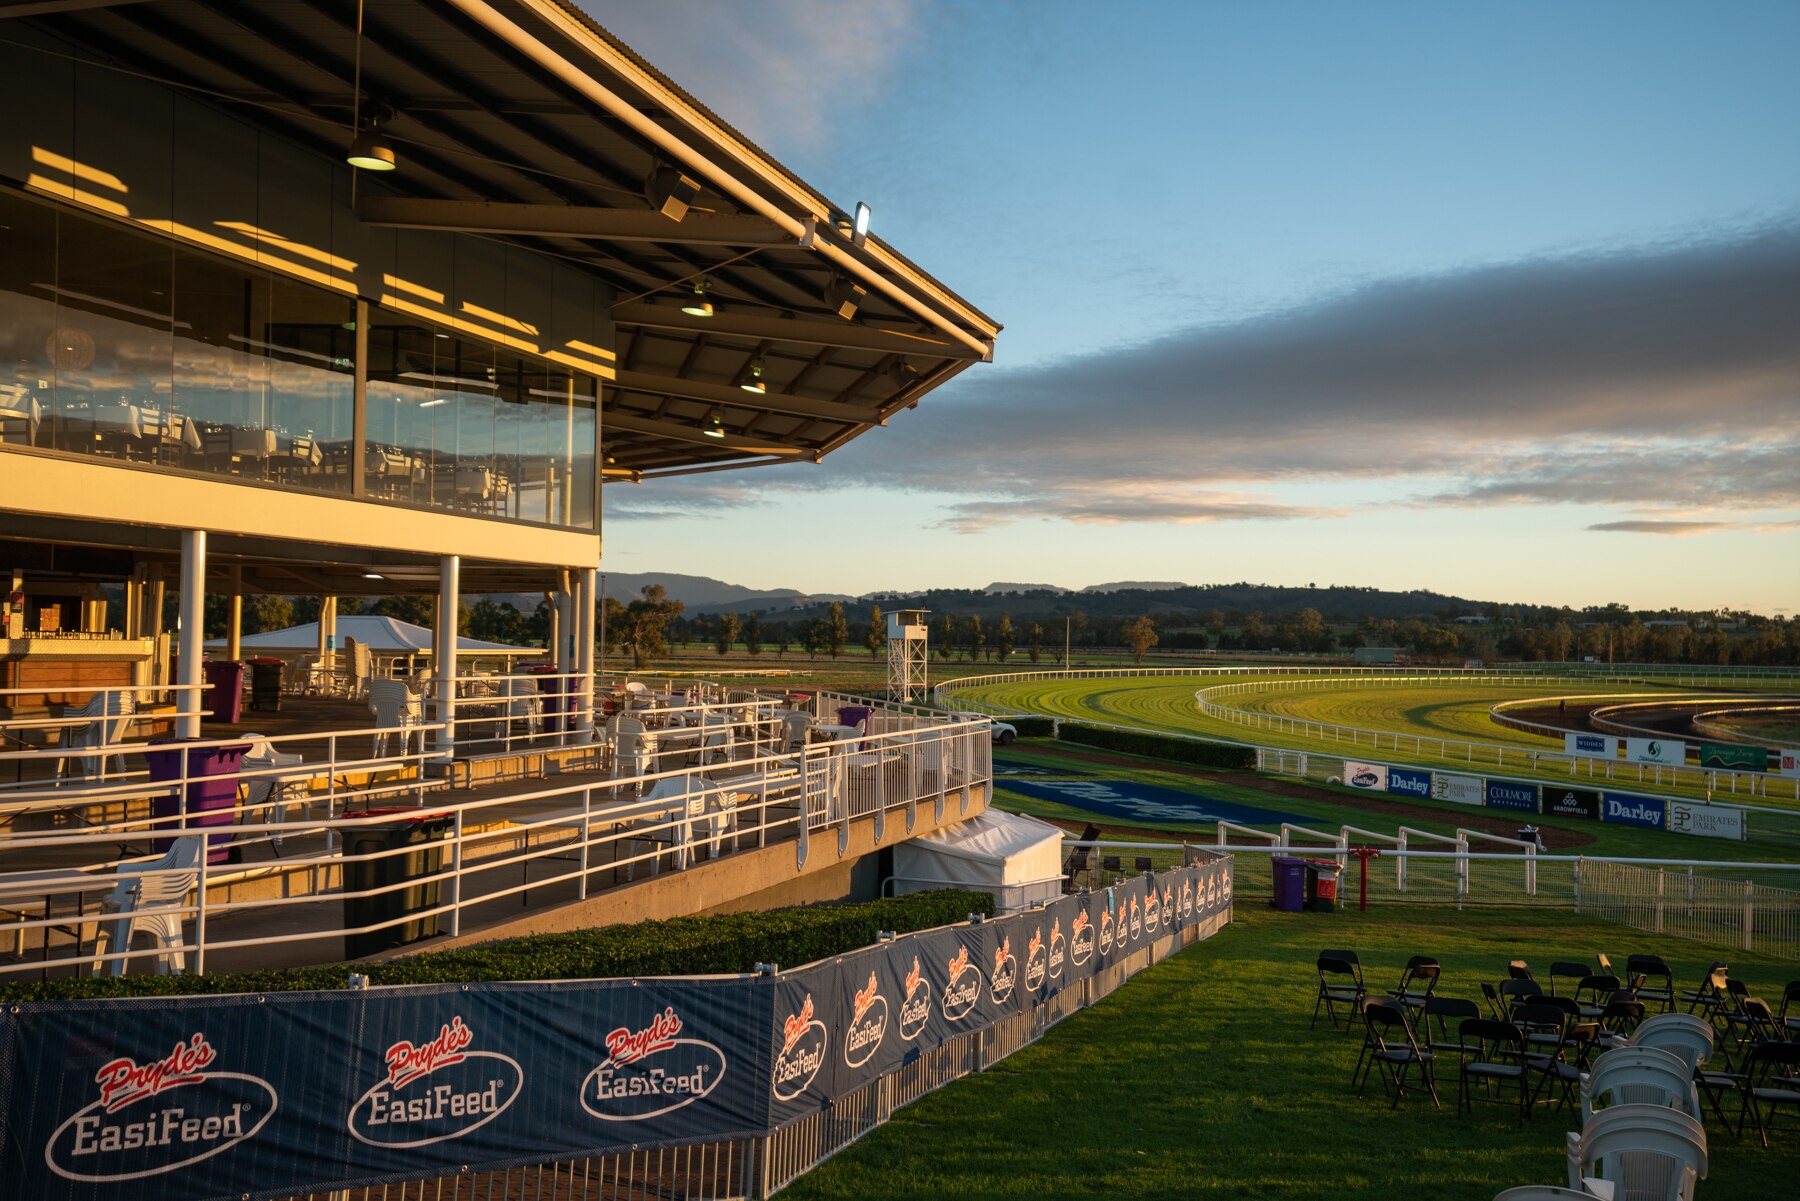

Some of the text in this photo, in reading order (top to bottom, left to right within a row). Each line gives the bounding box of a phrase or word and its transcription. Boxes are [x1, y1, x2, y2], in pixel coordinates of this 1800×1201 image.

[1391, 774, 1428, 794] Darley
[1490, 786, 1533, 802] COOLMORE
[1553, 805, 1588, 815] ARROWFIELD
[1608, 800, 1661, 824] Darley
[1692, 813, 1738, 827] EMIRATES
[1692, 820, 1717, 831] PARK
[606, 1006, 683, 1062] Pryde's
[385, 1016, 473, 1082] Pryde's
[95, 1032, 216, 1106] Pryde's
[596, 1065, 705, 1100] EasiFeed
[367, 1080, 500, 1125] EasiFeed
[71, 1103, 244, 1156] EasiFeed
